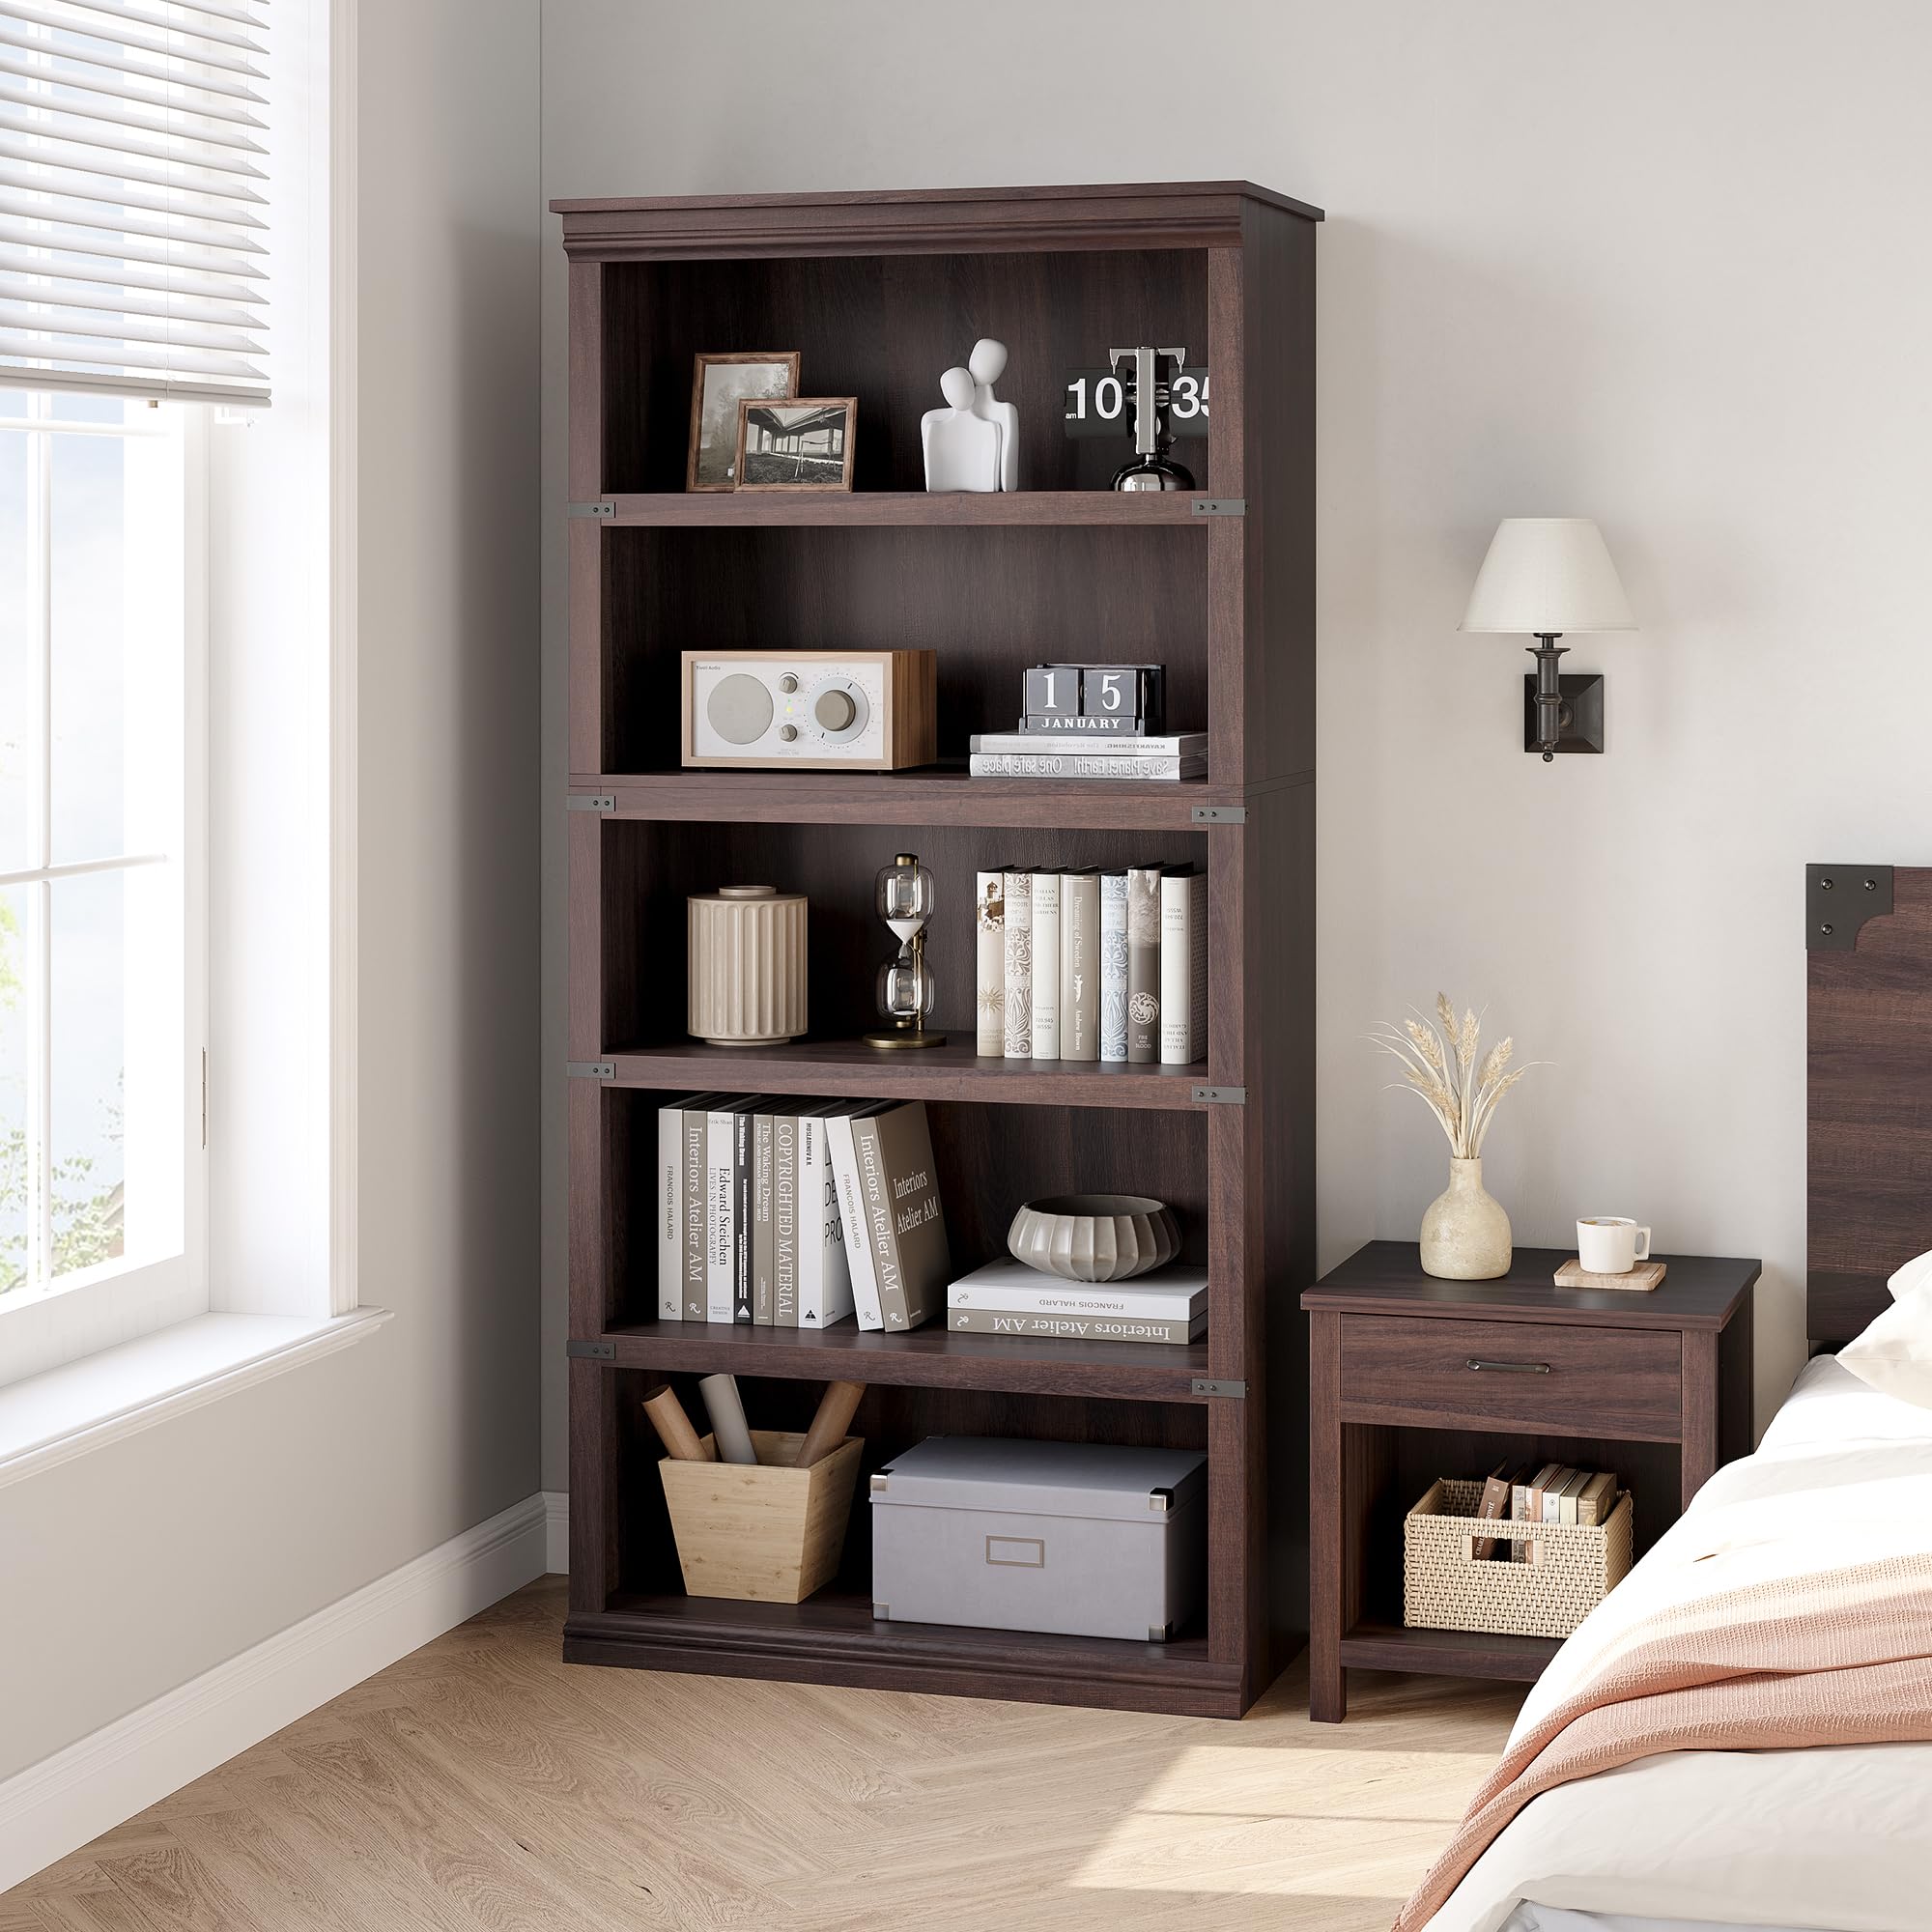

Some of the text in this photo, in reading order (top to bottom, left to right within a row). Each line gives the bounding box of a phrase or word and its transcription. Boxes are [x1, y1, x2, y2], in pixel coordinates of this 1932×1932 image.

[1067, 377, 1123, 420] 10
[1042, 671, 1122, 711] 1 5
[1041, 718, 1122, 729] JANUARY
[1073, 896, 1083, 931] Dreaming
[1073, 940, 1083, 968] Sweden
[760, 1122, 771, 1222] The Waking Dream
[893, 1171, 928, 1199] Interiors
[689, 1126, 704, 1283] Interiors Atelier AM
[709, 1192, 717, 1202] IN
[719, 1167, 730, 1265] Edward Steichen
[842, 1174, 862, 1249] FRANCOIS HALARD
[860, 1134, 899, 1292] Interiors Atelier AM
[897, 1196, 939, 1236] Atelier AM
[778, 1123, 794, 1318] COPYRIGHTED MATERIAL
[1038, 1298, 1124, 1311] FRANCOIS HALARD
[992, 1317, 1171, 1341] Interiors Atelier AM
